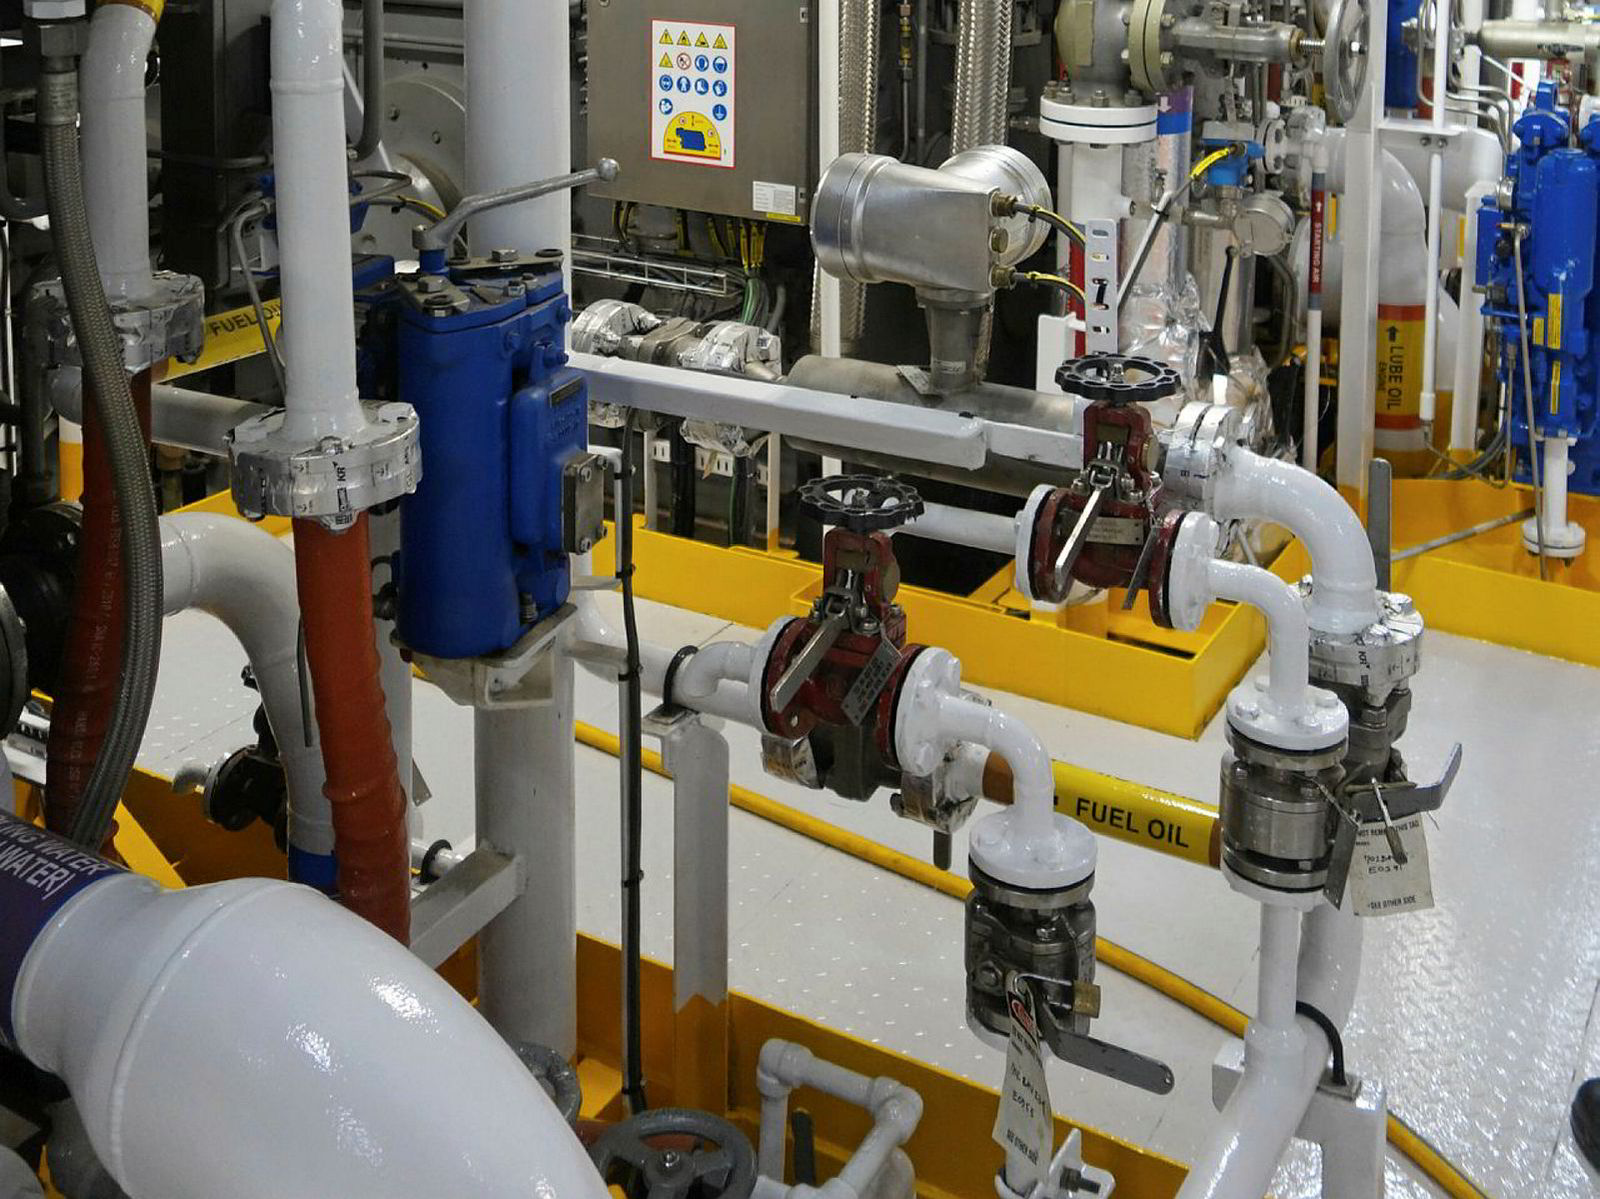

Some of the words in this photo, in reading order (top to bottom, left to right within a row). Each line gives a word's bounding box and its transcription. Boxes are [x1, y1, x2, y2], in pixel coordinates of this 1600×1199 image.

[1313, 222, 1321, 266] STARTING
[1312, 267, 1320, 283] AIR
[211, 313, 259, 336] FUEL
[1389, 346, 1404, 383] LUBE
[1387, 388, 1402, 410] OIL
[1076, 797, 1139, 833] FUEL
[1148, 819, 1189, 848] OIL
[0, 844, 76, 900] WATER)
[33, 840, 111, 875] WATER
